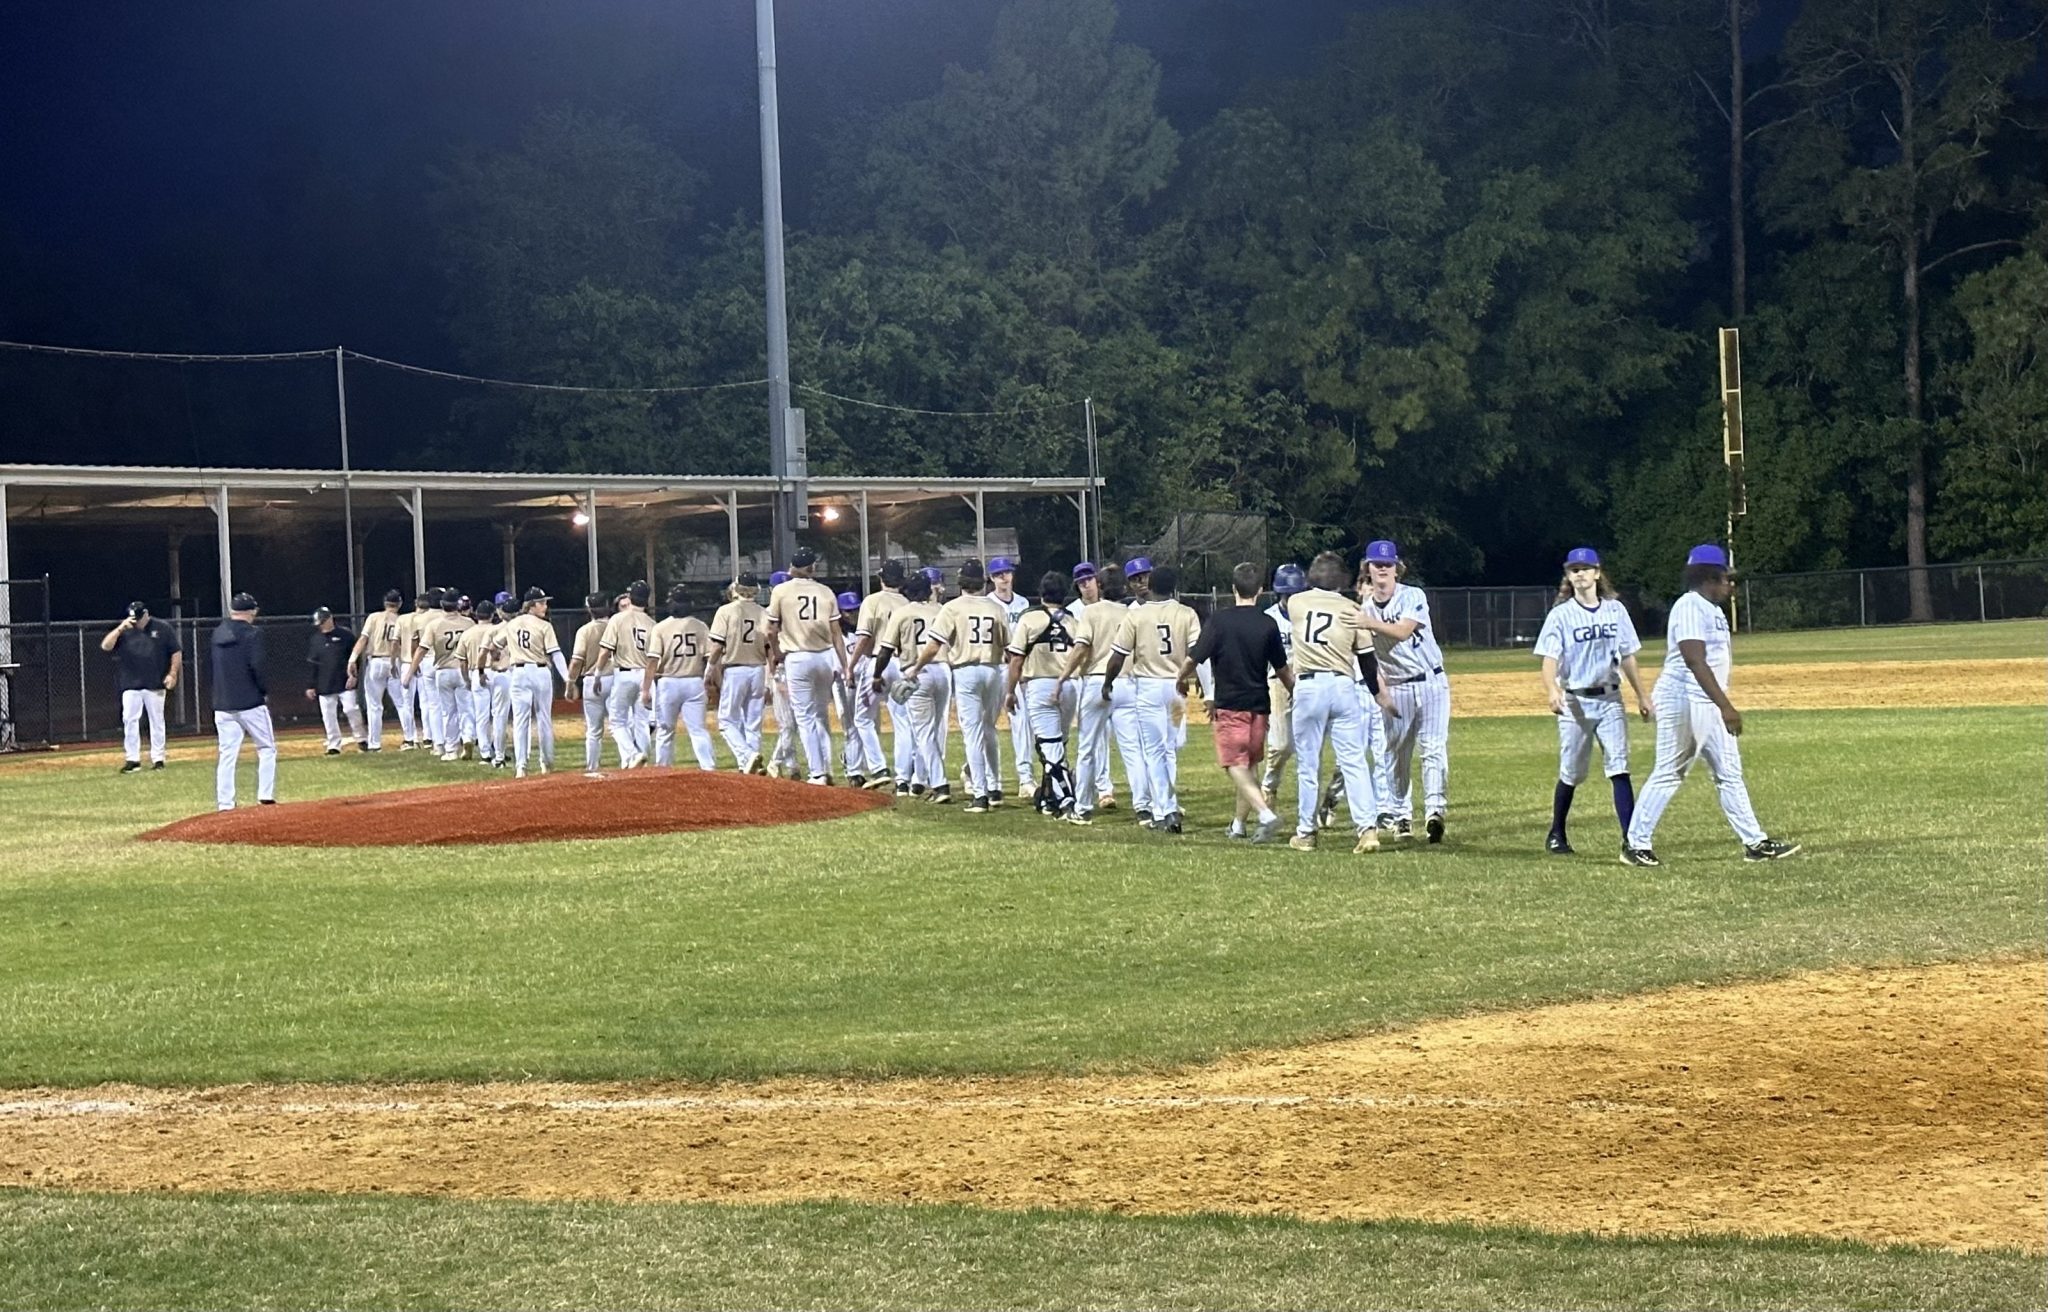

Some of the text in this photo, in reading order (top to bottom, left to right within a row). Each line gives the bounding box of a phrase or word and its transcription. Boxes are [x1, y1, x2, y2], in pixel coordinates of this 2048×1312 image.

[797, 595, 817, 620] 21
[517, 629, 531, 649] 18
[633, 627, 646, 651] 15
[743, 619, 754, 643] 2
[969, 616, 995, 644] 33
[1157, 625, 1172, 655] 3
[1305, 611, 1333, 645] 12
[673, 633, 696, 657] 25
